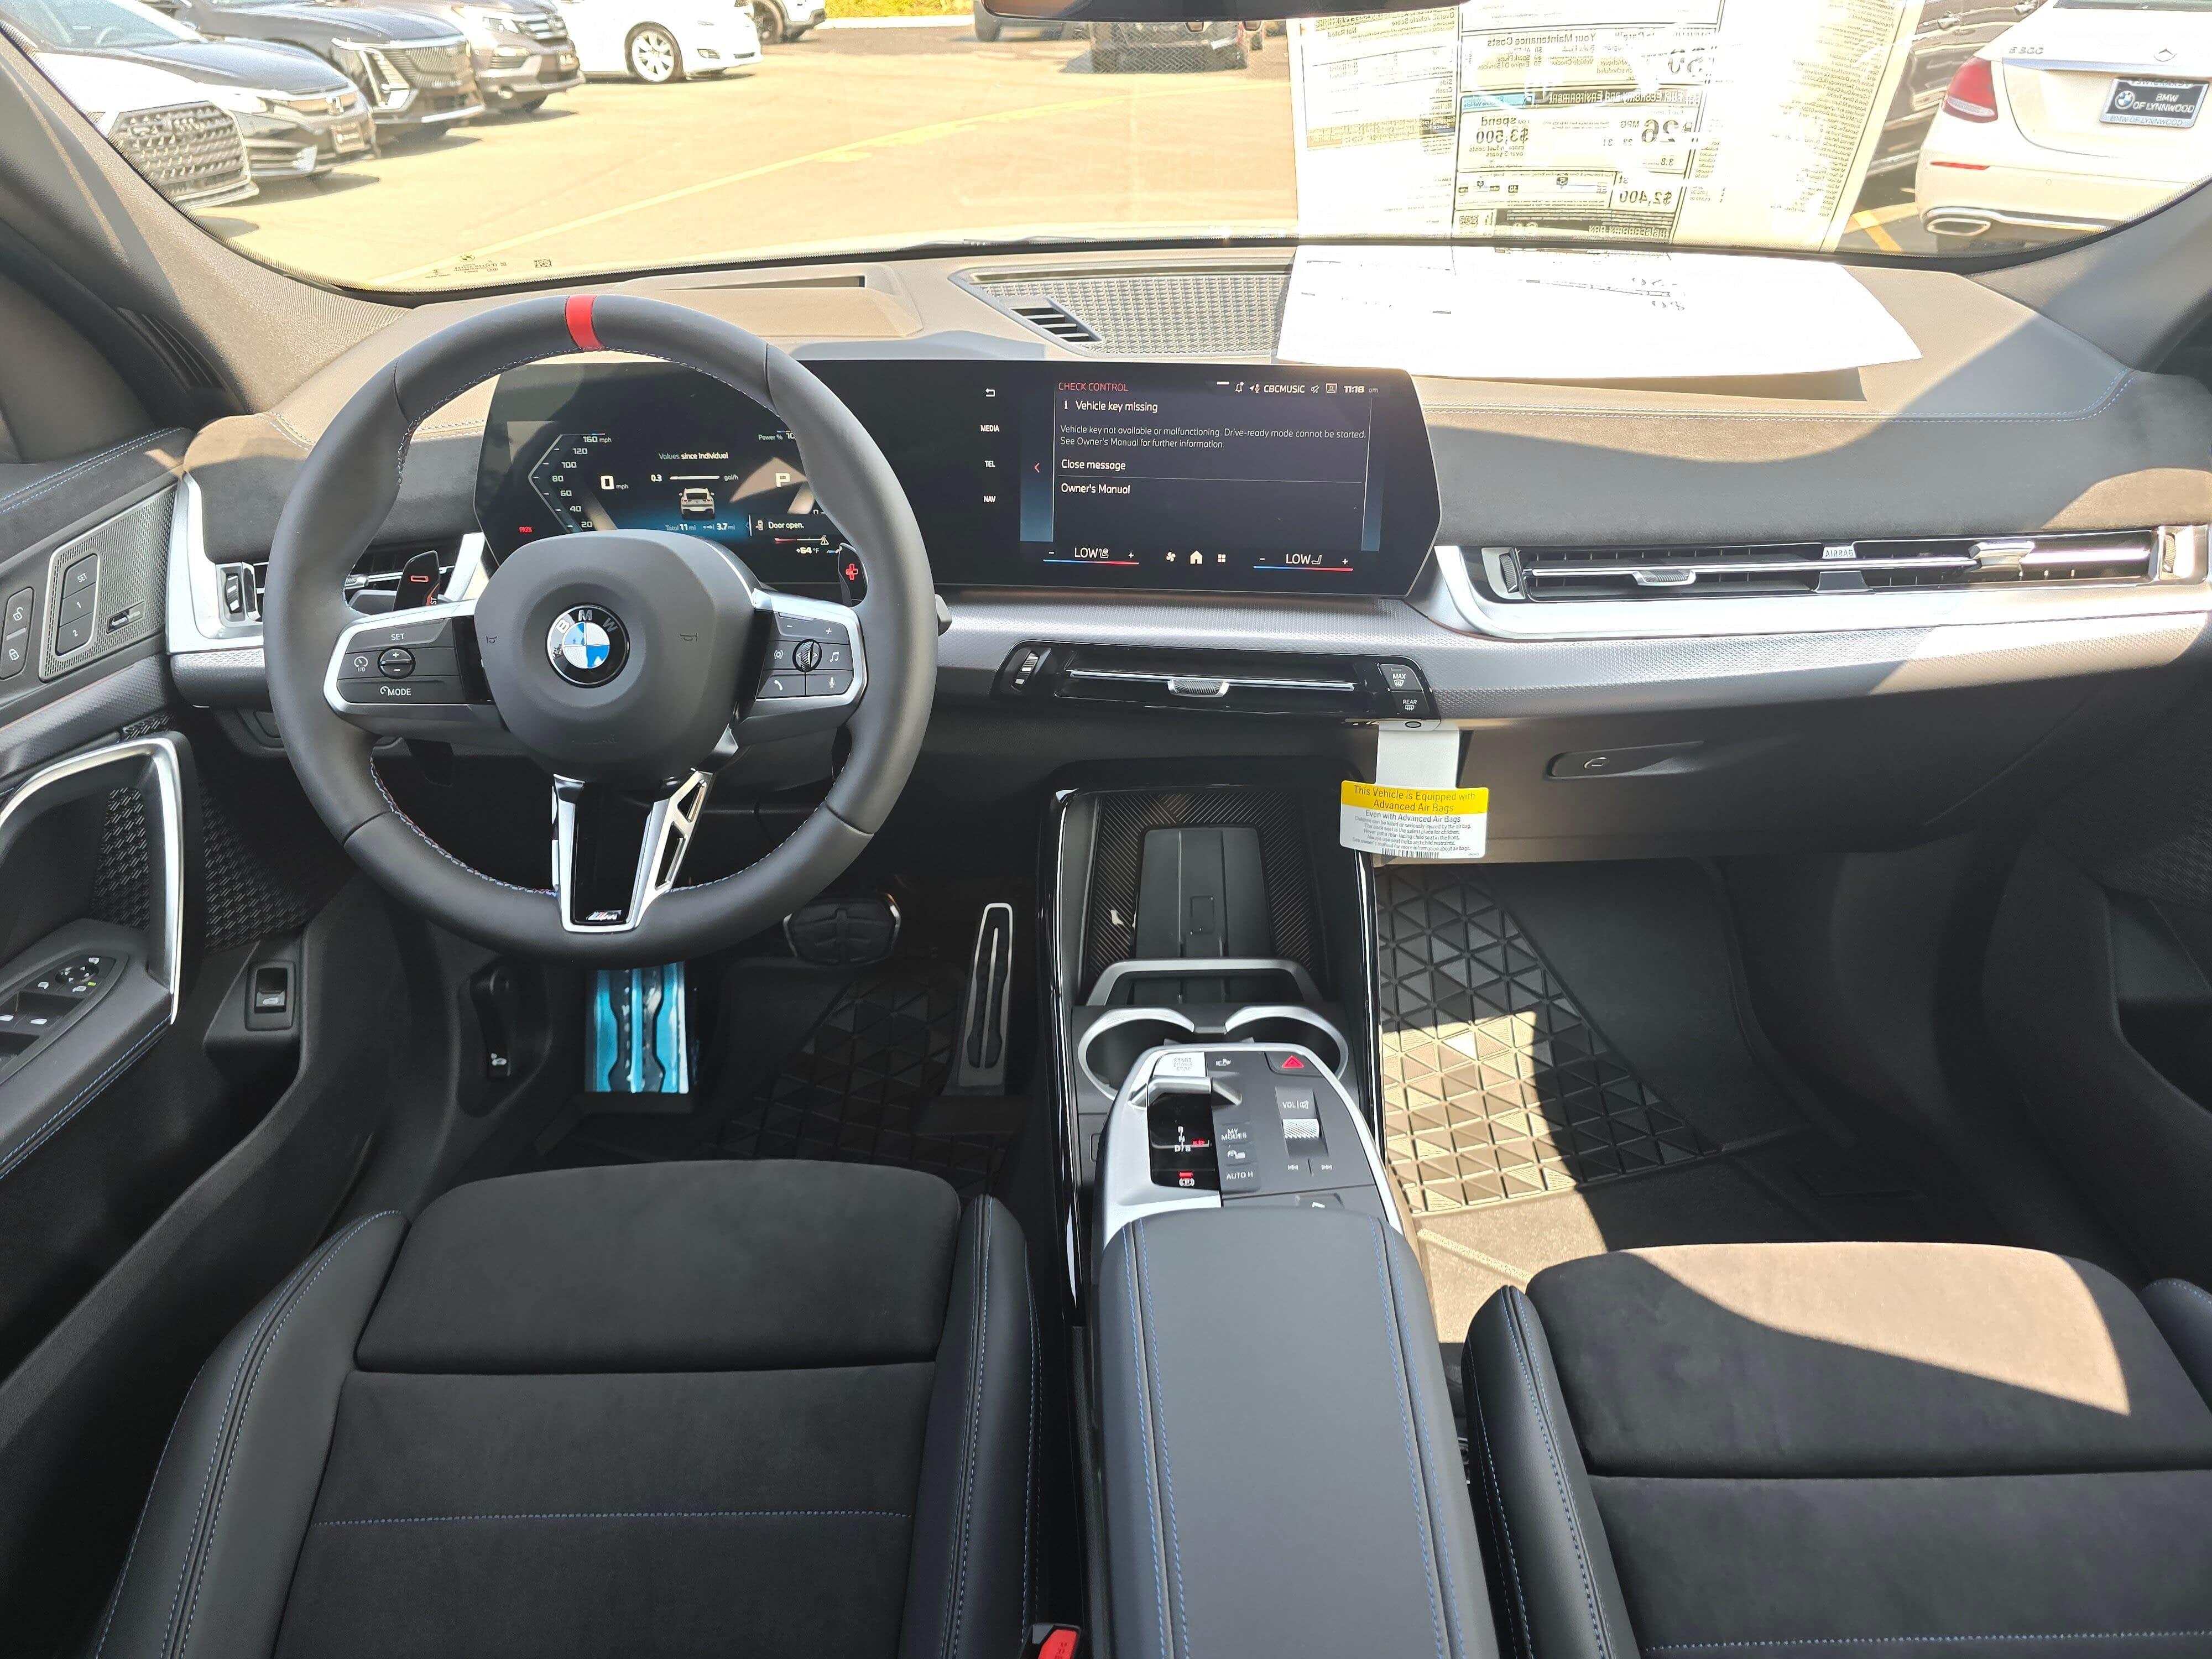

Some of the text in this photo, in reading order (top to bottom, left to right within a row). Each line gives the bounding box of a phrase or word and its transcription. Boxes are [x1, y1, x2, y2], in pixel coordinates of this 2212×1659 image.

[2156, 93, 2179, 103] BMW
[2133, 101, 2194, 113] OF LYNNWOOD
[2141, 117, 2183, 126] LYNNWOOD
[1058, 382, 1129, 392] CHECK CONTROL
[1264, 385, 1305, 393] CBCMUSIC
[1076, 400, 1158, 414] Vehicle key missing
[1060, 425, 1087, 434] Vehicle
[1089, 425, 1102, 435] key
[1104, 426, 1116, 435] not
[1118, 426, 1152, 436] available
[1163, 427, 1222, 437] malfunctioning.
[1224, 428, 1269, 439] Drive-ready
[1271, 429, 1293, 438] mode
[1295, 430, 1322, 439] cannot
[1324, 430, 1334, 439] be
[1336, 430, 1366, 439] started.
[1060, 436, 1075, 445] See
[1077, 437, 1109, 446] Owner's
[1110, 437, 1138, 446] Manual
[1152, 439, 1177, 447] further
[1179, 439, 1224, 448] information.
[1061, 458, 1126, 472] Close message
[600, 475, 614, 490] 0
[775, 472, 790, 487] P
[1061, 483, 1131, 494] Owner's Manual
[1074, 547, 1098, 559] LOW
[1286, 554, 1310, 565] LOW
[77, 573, 87, 582] SET
[1354, 785, 1475, 802] This Vehicle is Equipped with
[1373, 800, 1453, 813] Advanced Air Bags
[1365, 810, 1381, 818] Even
[1383, 811, 1396, 820] with
[1398, 813, 1431, 822] Advanced
[1444, 816, 1461, 824] Bags
